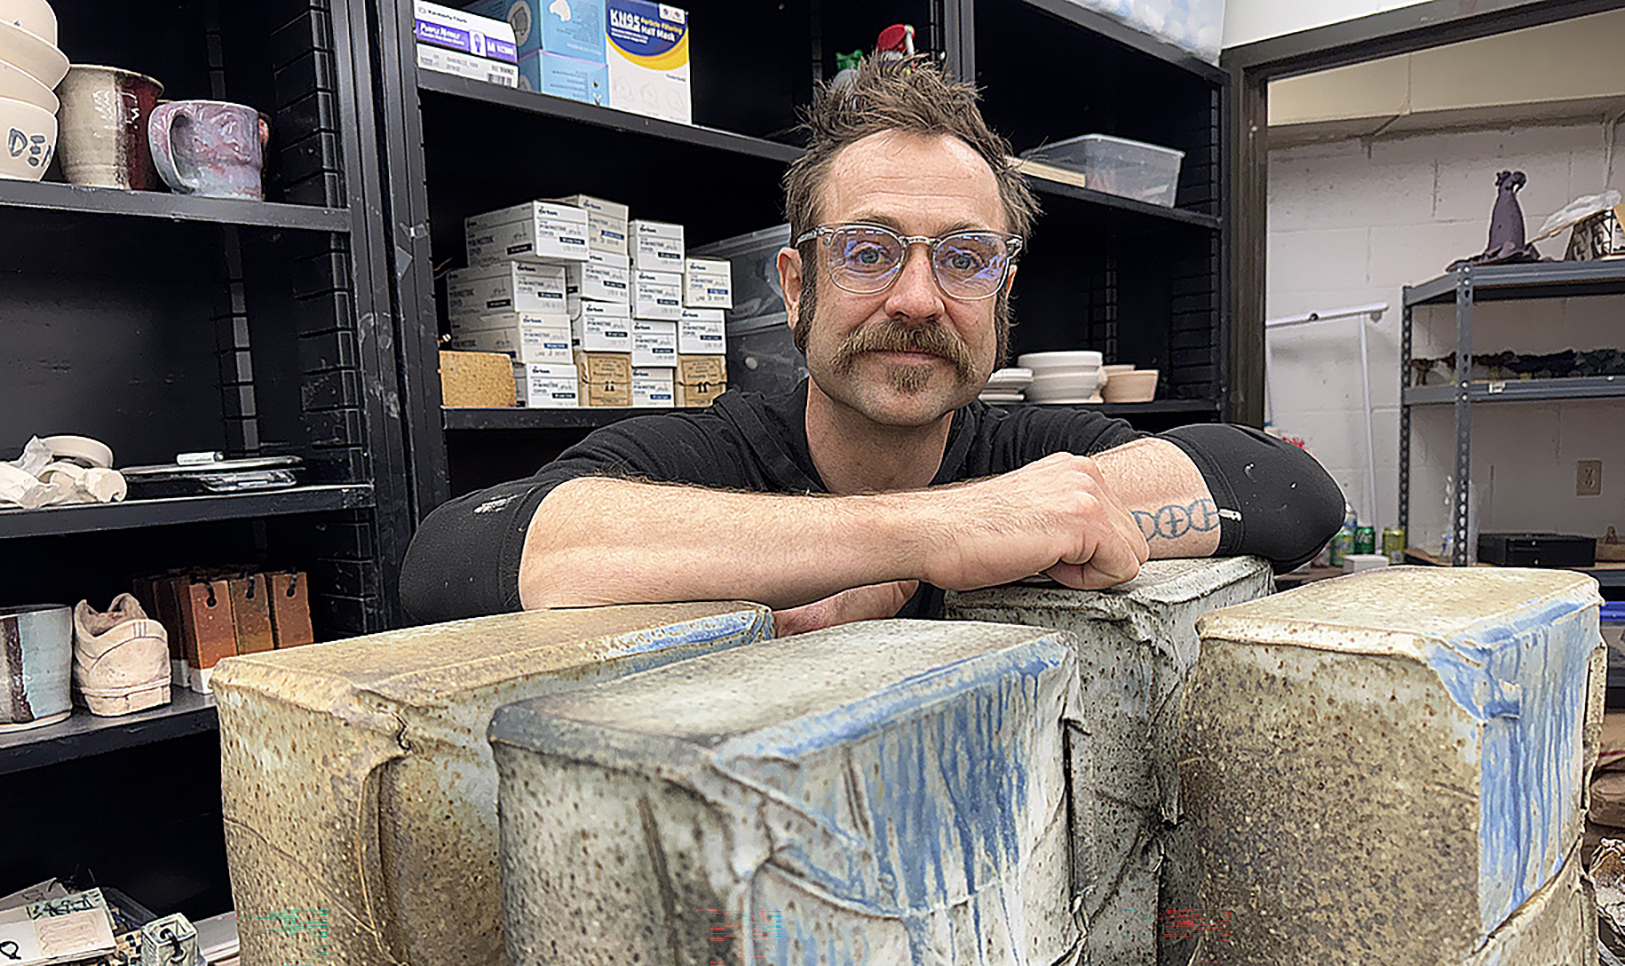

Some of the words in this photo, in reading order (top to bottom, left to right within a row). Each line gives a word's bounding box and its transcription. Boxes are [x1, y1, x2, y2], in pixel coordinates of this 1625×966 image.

[610, 8, 641, 33] KN95
[641, 25, 656, 37] Half
[656, 29, 676, 42] Mask
